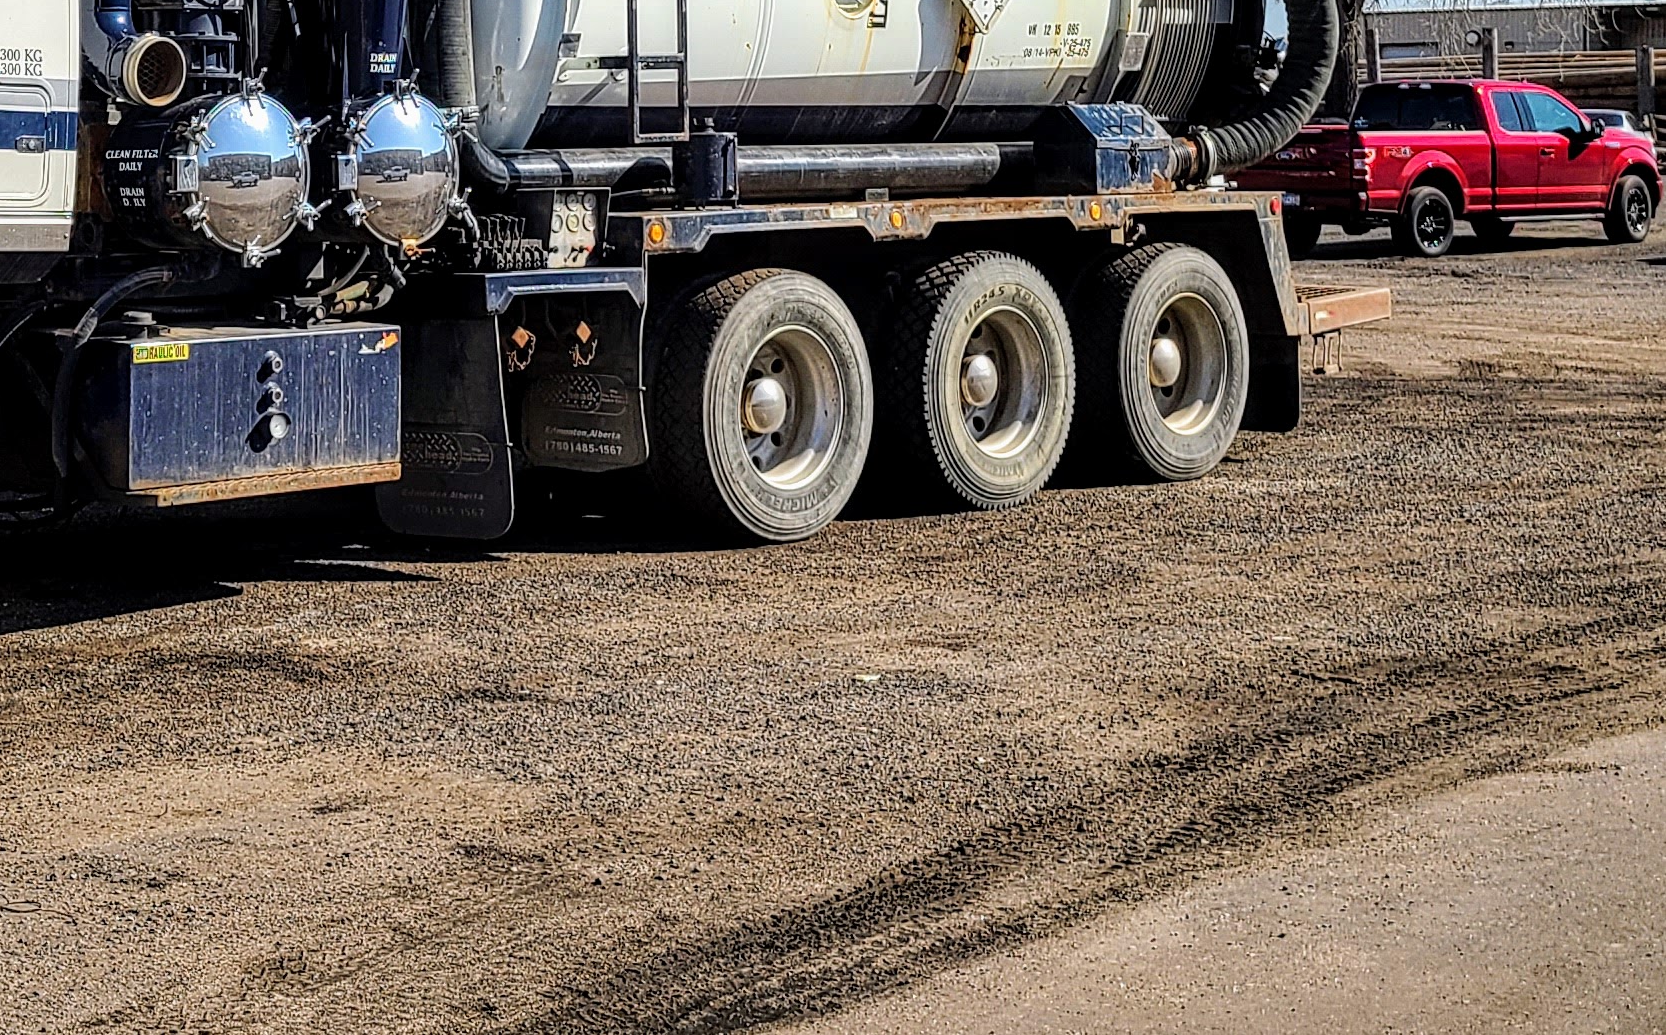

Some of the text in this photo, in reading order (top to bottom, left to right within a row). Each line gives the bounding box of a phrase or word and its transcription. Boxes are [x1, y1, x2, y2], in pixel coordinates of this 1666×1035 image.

[24, 48, 43, 63] KG
[370, 52, 397, 63] DRAIN
[24, 62, 43, 76] KG
[370, 63, 397, 73] DAILY
[105, 149, 131, 159] CLEAN
[119, 161, 143, 172] DAILY
[119, 187, 145, 197] DRAIN
[122, 197, 146, 207] DILY
[135, 344, 186, 360] RAULIC OIL
